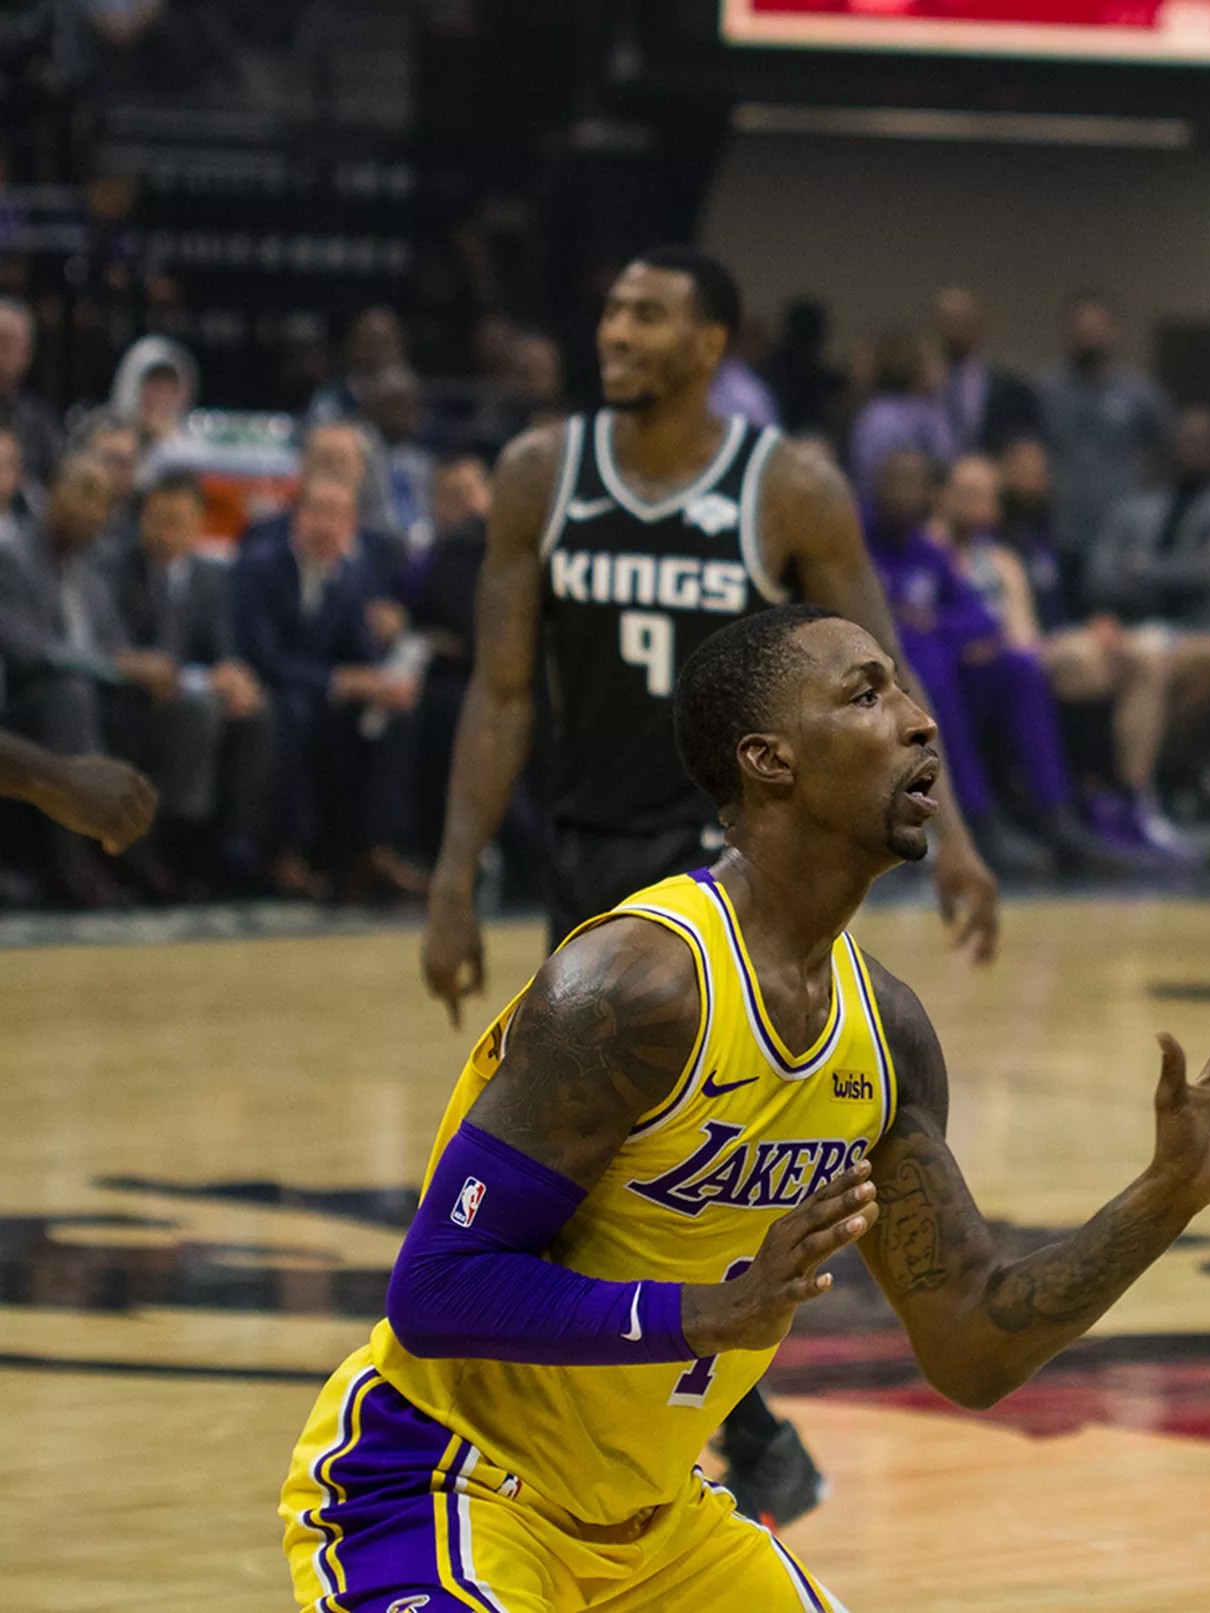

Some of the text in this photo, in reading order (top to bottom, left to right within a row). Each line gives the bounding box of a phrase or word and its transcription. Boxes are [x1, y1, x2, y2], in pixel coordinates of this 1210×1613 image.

[551, 549, 747, 614] KINGS
[620, 610, 673, 697] 9
[832, 1071, 873, 1100] wish
